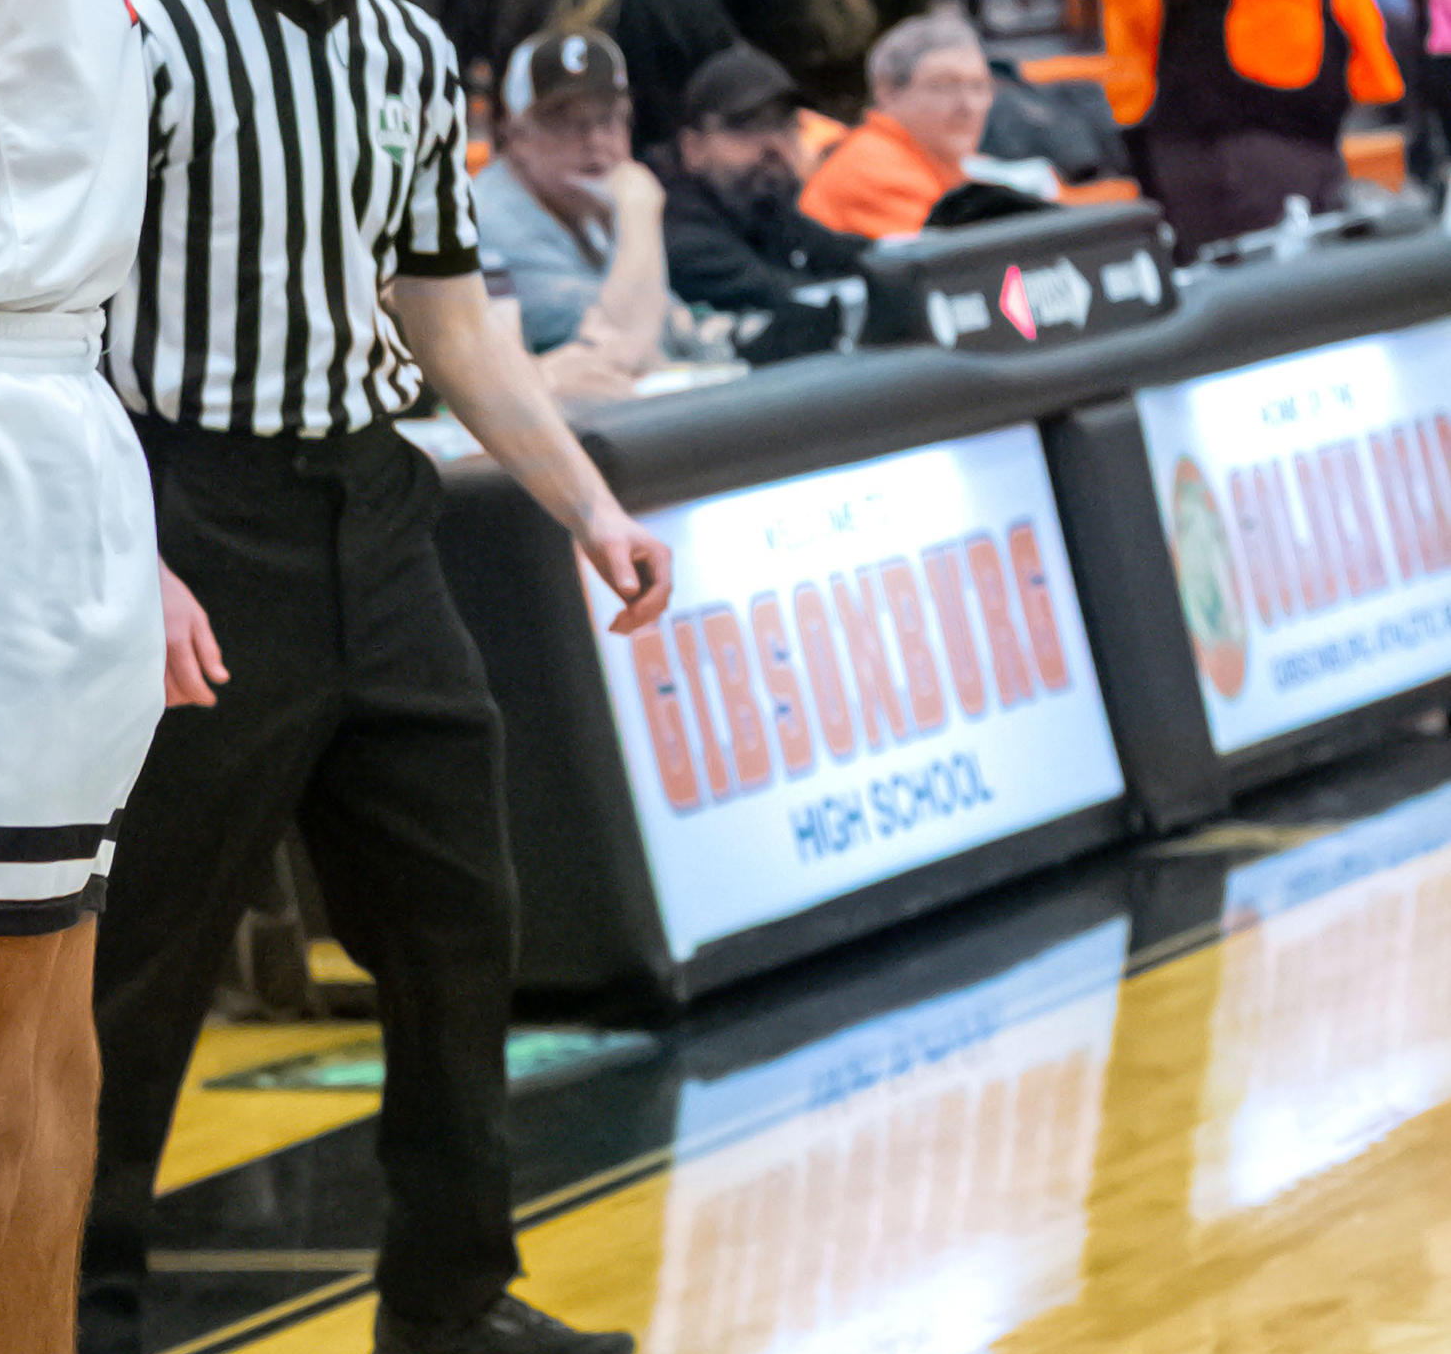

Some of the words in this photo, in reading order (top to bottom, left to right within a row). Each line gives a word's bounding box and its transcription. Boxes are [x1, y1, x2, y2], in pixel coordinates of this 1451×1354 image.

[631, 516, 1070, 816] GIBSONBURG
[790, 791, 872, 863] HIGH
[869, 750, 996, 840] SCHOOL
